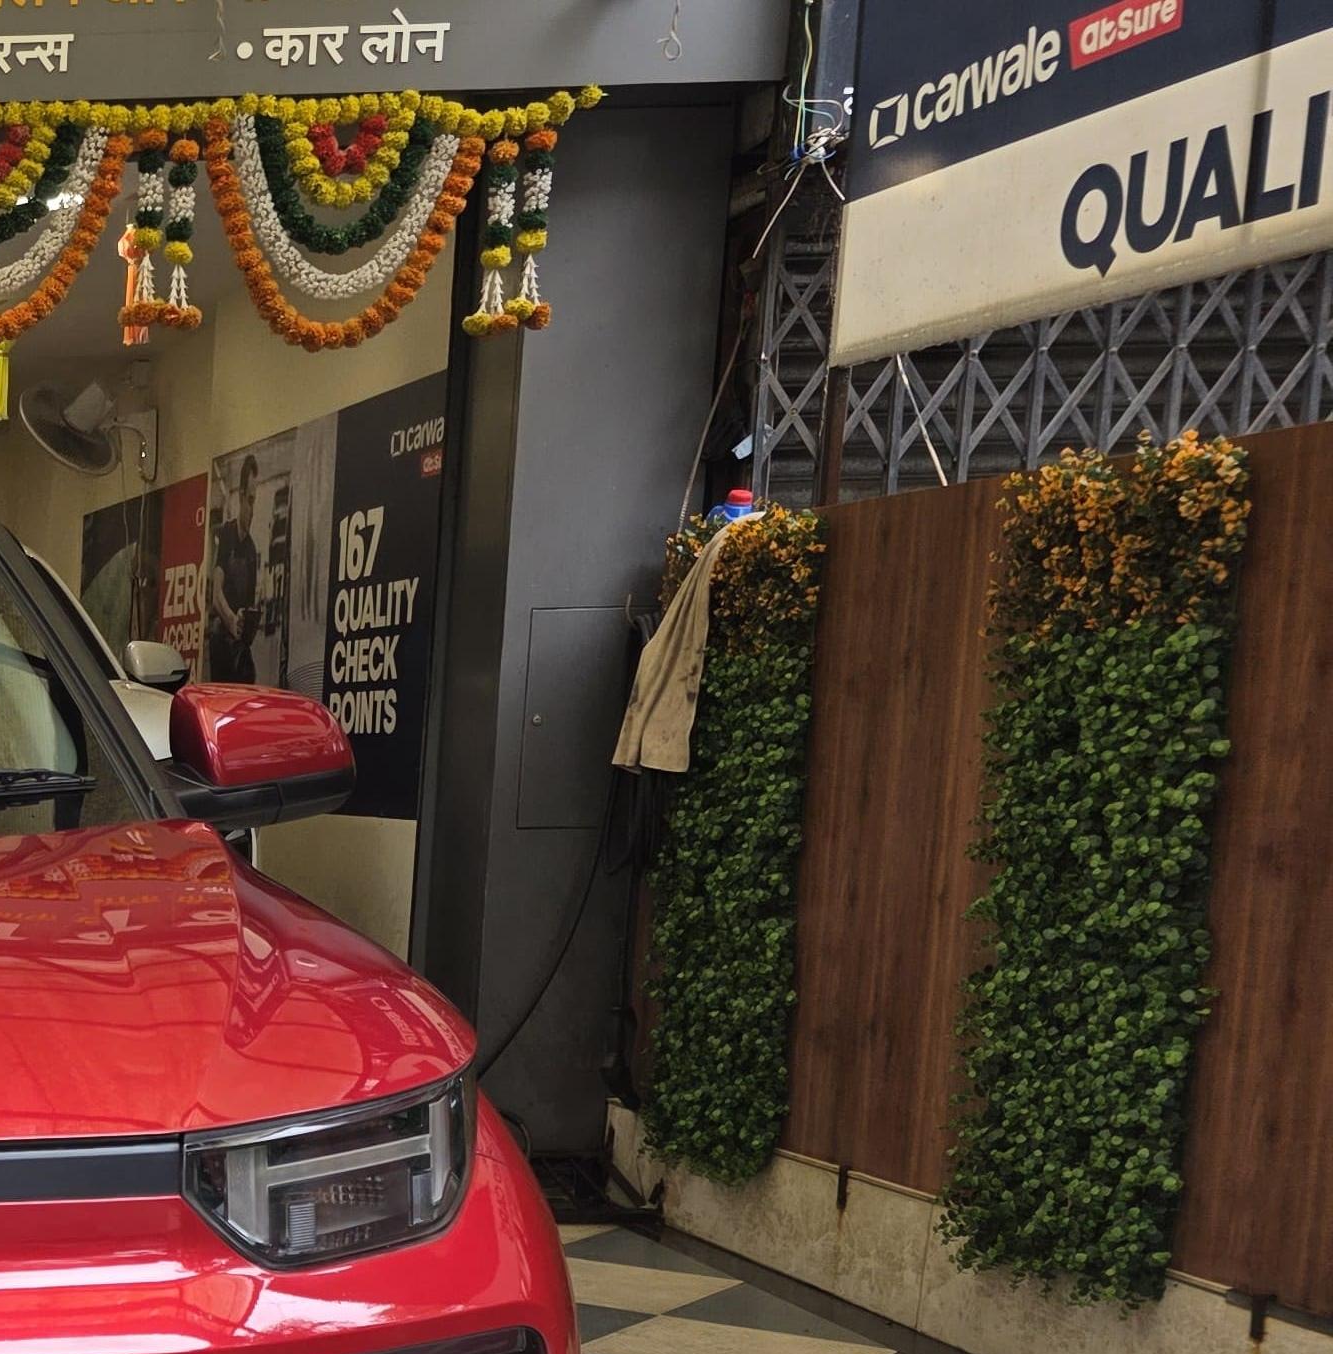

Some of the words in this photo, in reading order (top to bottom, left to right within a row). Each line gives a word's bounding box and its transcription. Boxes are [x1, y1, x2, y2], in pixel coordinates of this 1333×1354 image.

[263, 25, 349, 67] कार
[359, 7, 450, 64] लोन
[913, 25, 1061, 132] carwale
[1060, 89, 1333, 278] QUALI
[338, 506, 384, 582] 167
[335, 577, 419, 637] QUALITY
[331, 635, 400, 684] CHECK
[330, 688, 397, 735] POINTS
